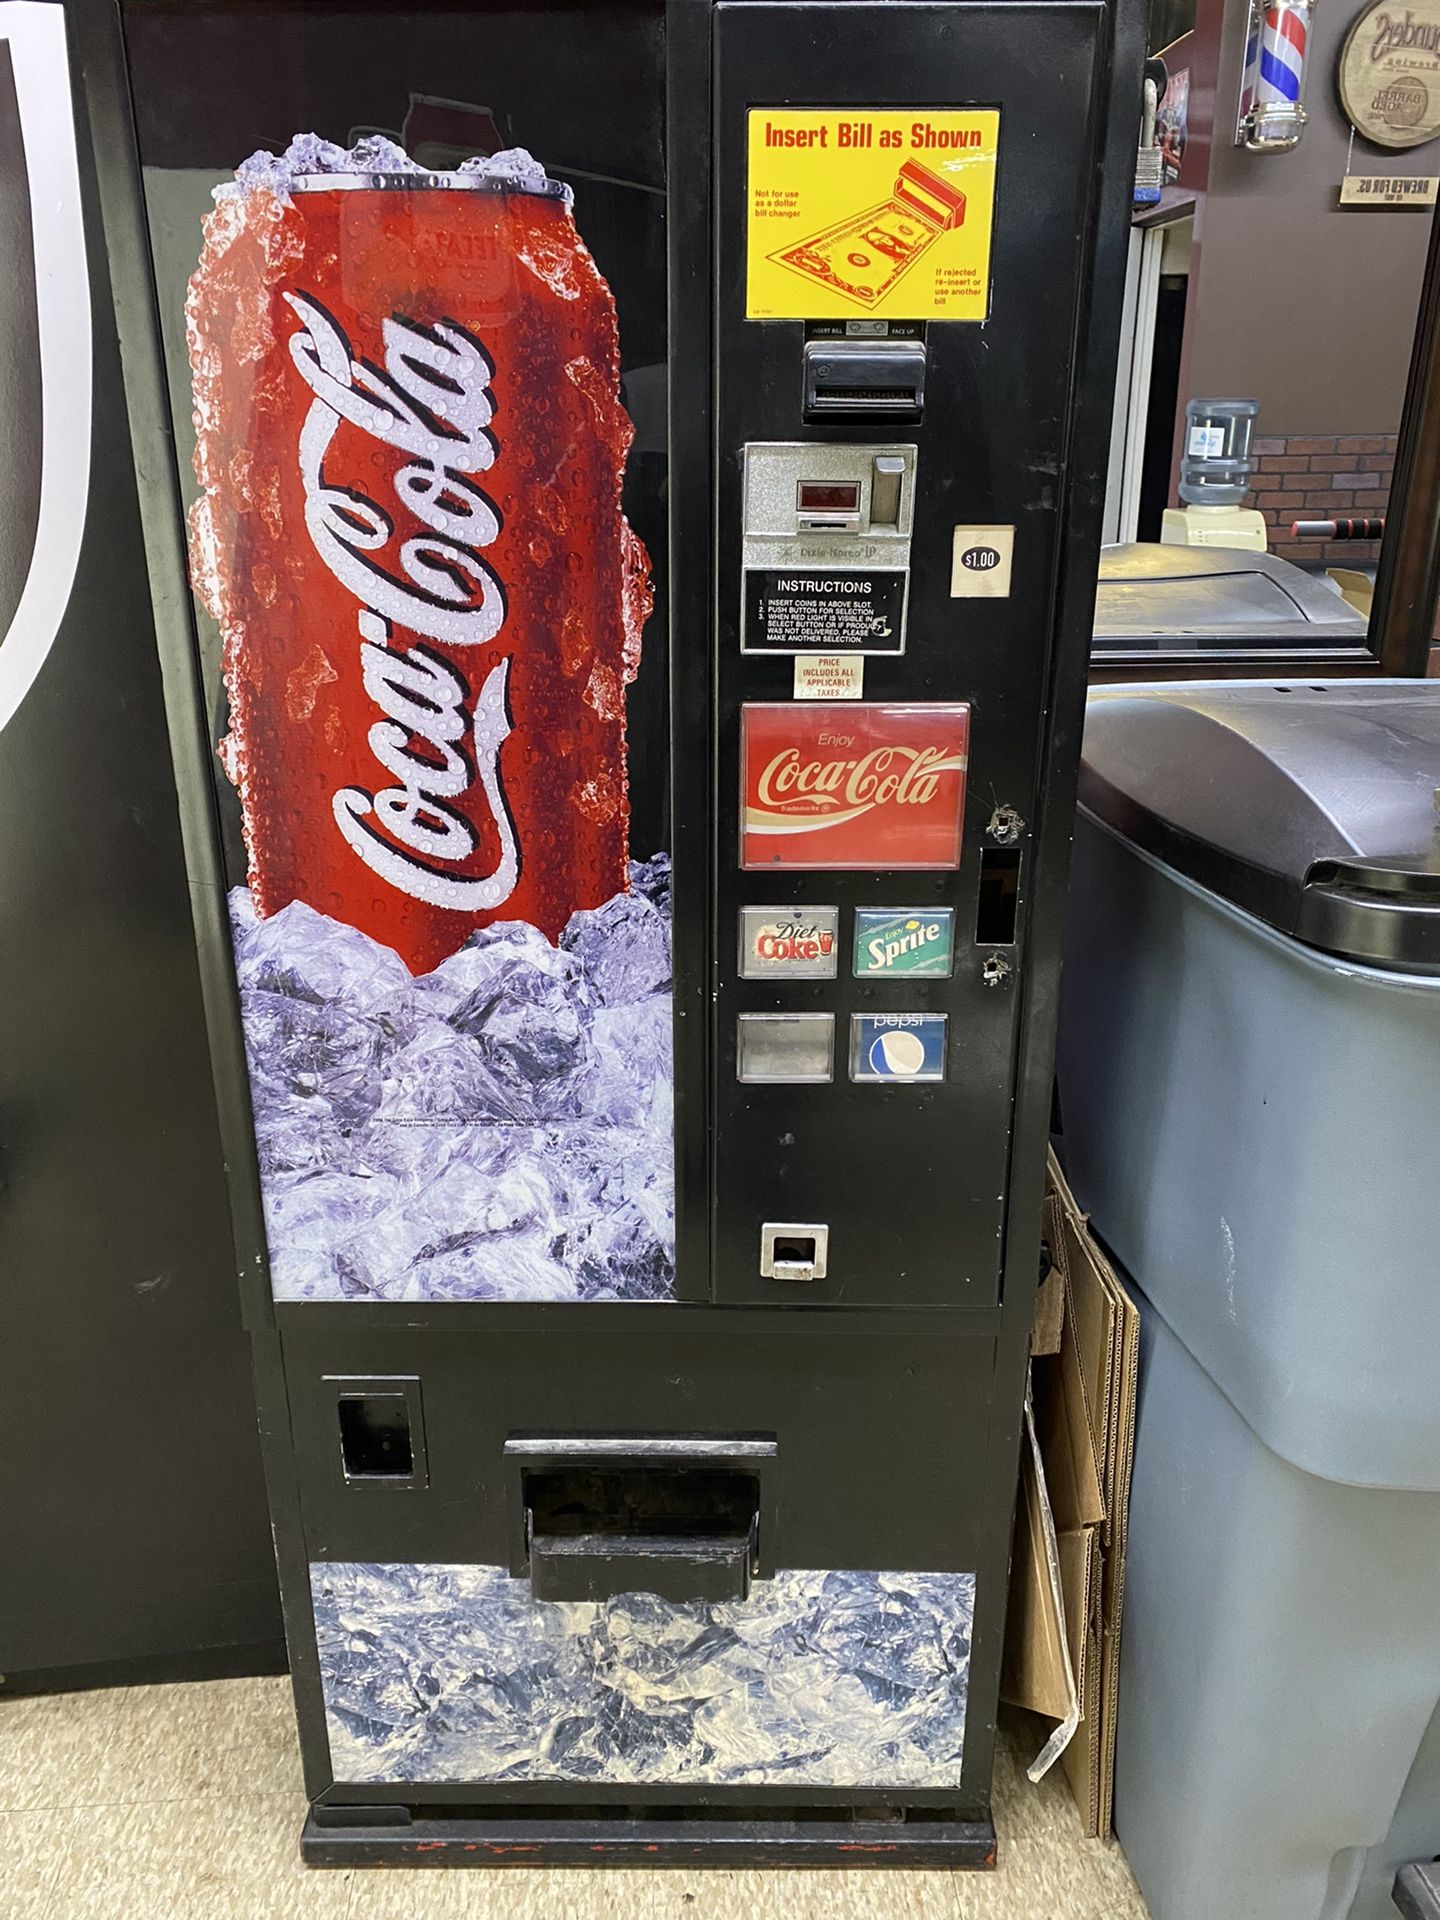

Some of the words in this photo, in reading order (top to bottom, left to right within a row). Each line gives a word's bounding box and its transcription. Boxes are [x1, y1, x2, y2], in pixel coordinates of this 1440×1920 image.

[765, 122, 828, 148] Insert
[837, 123, 873, 148] Bill
[879, 128, 903, 148] as
[910, 123, 982, 149] Shown
[755, 189, 769, 198] Not
[771, 189, 783, 198] for
[773, 199, 797, 207] dollar
[754, 209, 767, 217] bill
[768, 209, 801, 219] changer
[935, 268, 942, 276] If
[944, 268, 977, 277] rejected
[935, 278, 970, 286] re-insert
[951, 288, 982, 296] another
[934, 297, 946, 305] bill
[831, 327, 843, 335] BILL
[965, 551, 995, 568] $1.00
[777, 579, 872, 594] INSTRUCTIONS
[282, 288, 523, 913] Coca-Cola
[768, 599, 793, 607] INSERT
[795, 599, 817, 607] COINS
[828, 600, 851, 608] ABOVE
[853, 601, 872, 609] SLOT.
[789, 606, 817, 614] BUTTON
[819, 607, 834, 615] FOR
[835, 608, 874, 616] SELECTION
[795, 620, 824, 628] BUTTON
[825, 621, 836, 629] OR
[837, 621, 845, 629] IF
[785, 627, 800, 635] NOT
[842, 629, 869, 637] PLEASE
[766, 634, 787, 642] MAKE
[823, 635, 863, 643] SELECTION.
[818, 658, 841, 667] PRICE
[803, 668, 840, 677] INCLUDES
[841, 668, 855, 677] ALL
[807, 678, 851, 687] APPLICABLE
[817, 688, 841, 697] TAXES
[817, 732, 855, 748] Enjoy
[757, 745, 949, 807] Coca-Cola
[776, 921, 819, 941] Diet
[757, 934, 820, 960] Coke
[867, 922, 940, 970] Sprite
